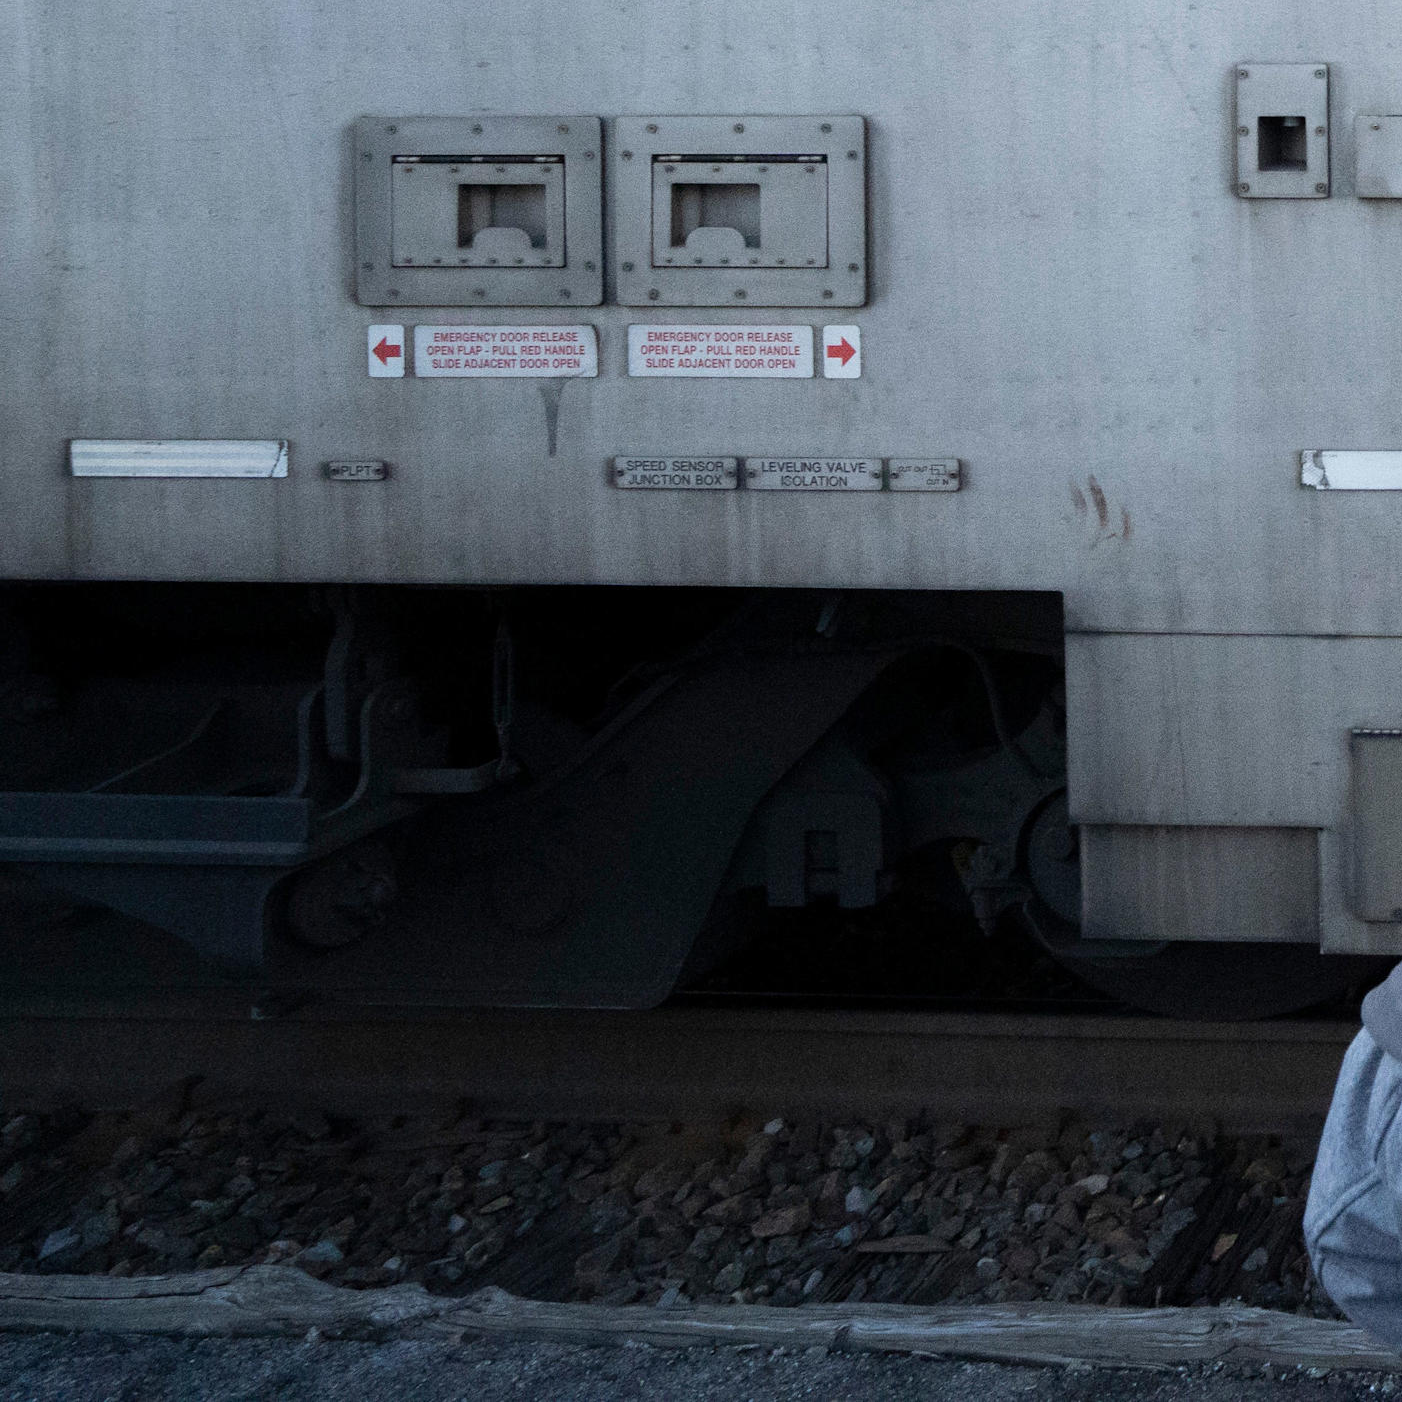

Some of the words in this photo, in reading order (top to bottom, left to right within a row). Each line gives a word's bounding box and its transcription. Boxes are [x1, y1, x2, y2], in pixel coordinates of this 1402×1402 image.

[434, 332, 496, 342] EMERGENCY
[500, 332, 529, 342] DOOR
[533, 332, 578, 342] RELEASE
[648, 332, 711, 342] EMERGENCY
[715, 332, 744, 342] DOOR
[748, 332, 793, 342] RELEASE
[427, 346, 454, 355] OPEN
[457, 346, 481, 355] FLAP
[492, 346, 517, 355] PULL
[521, 346, 541, 355] RED
[545, 346, 585, 355] HANDLE
[640, 346, 668, 355] OPEN
[671, 346, 696, 355] FLAP
[706, 346, 732, 355] PULL
[736, 346, 756, 355] RED
[759, 346, 800, 355] HANDLE
[432, 359, 460, 368] SLIDE
[464, 359, 517, 368] ADJACENT
[520, 359, 549, 368] DOOR
[552, 359, 580, 368] OPEN
[646, 359, 674, 368] SLIDE
[678, 359, 731, 368] ADJACENT
[734, 359, 764, 368] DOOR
[767, 359, 795, 368] OPEN
[341, 465, 373, 476] PLPT
[626, 461, 666, 472] SPEED
[672, 461, 724, 472] SENSOR
[761, 462, 814, 474] LEVELING
[819, 462, 867, 474] VALVE
[629, 474, 692, 486] JUNCTION
[695, 474, 723, 486] BOX
[781, 475, 848, 487] ISOLATION
